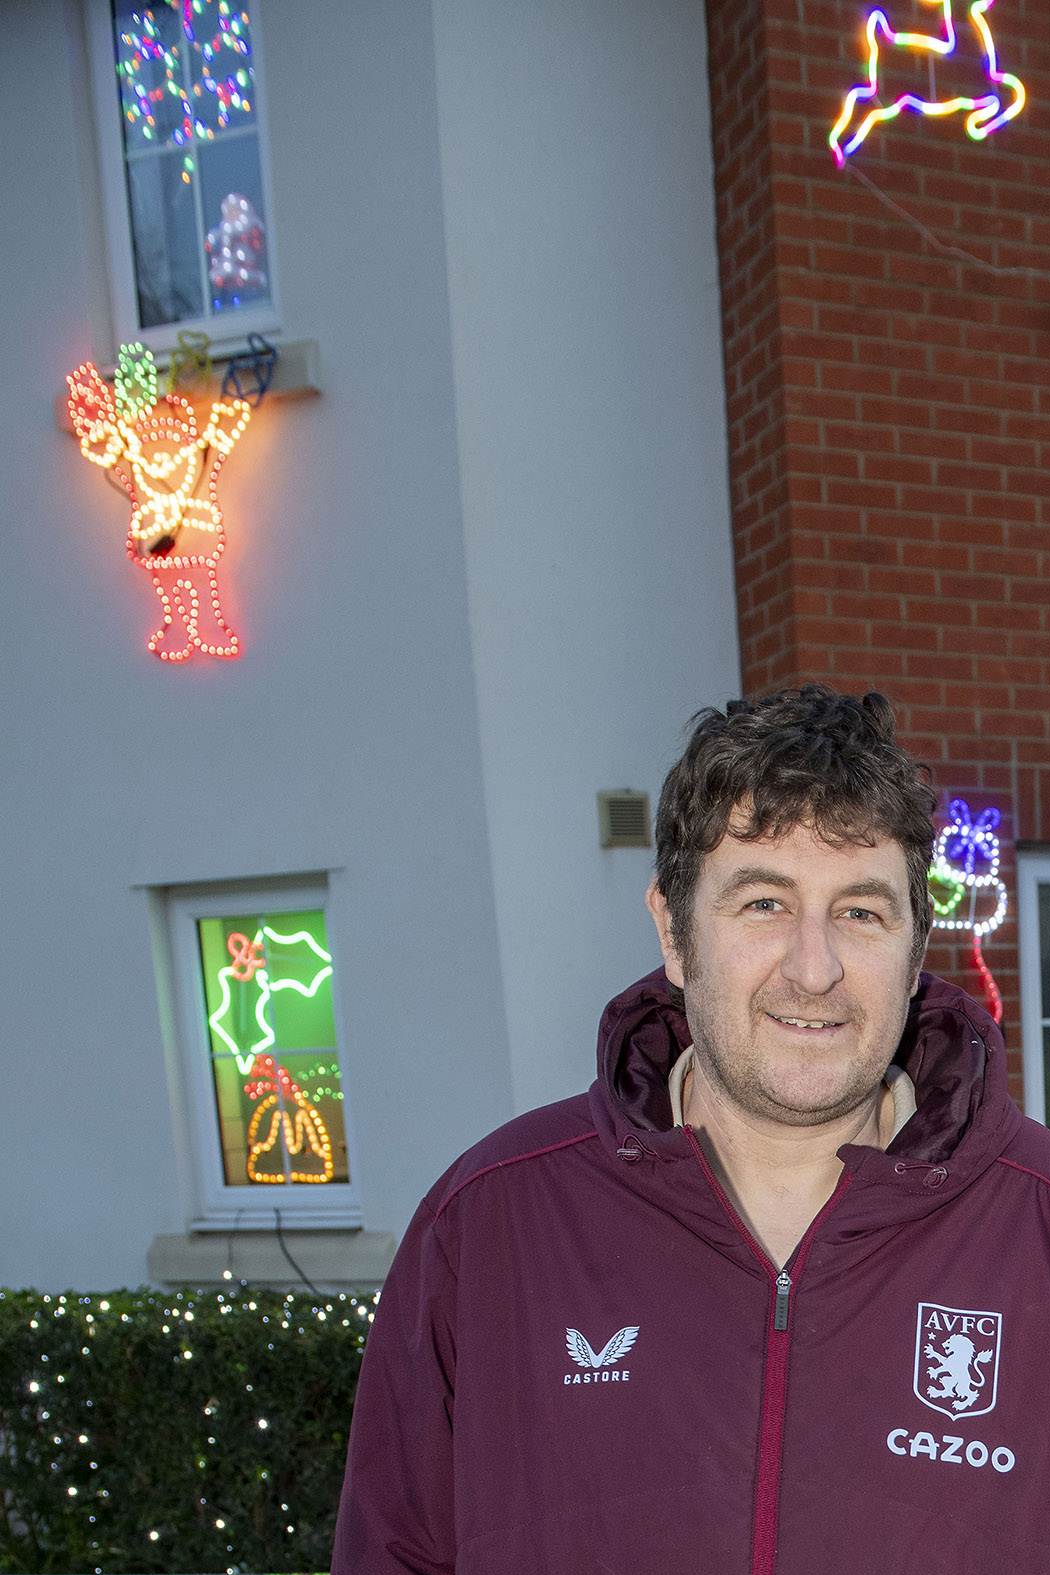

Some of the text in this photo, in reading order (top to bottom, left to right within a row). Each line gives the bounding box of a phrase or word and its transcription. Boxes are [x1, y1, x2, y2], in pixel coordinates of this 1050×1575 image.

[924, 1310, 995, 1337] AVFC
[563, 1370, 630, 1385] CASTORE
[886, 1428, 1016, 1473] CAZOO
